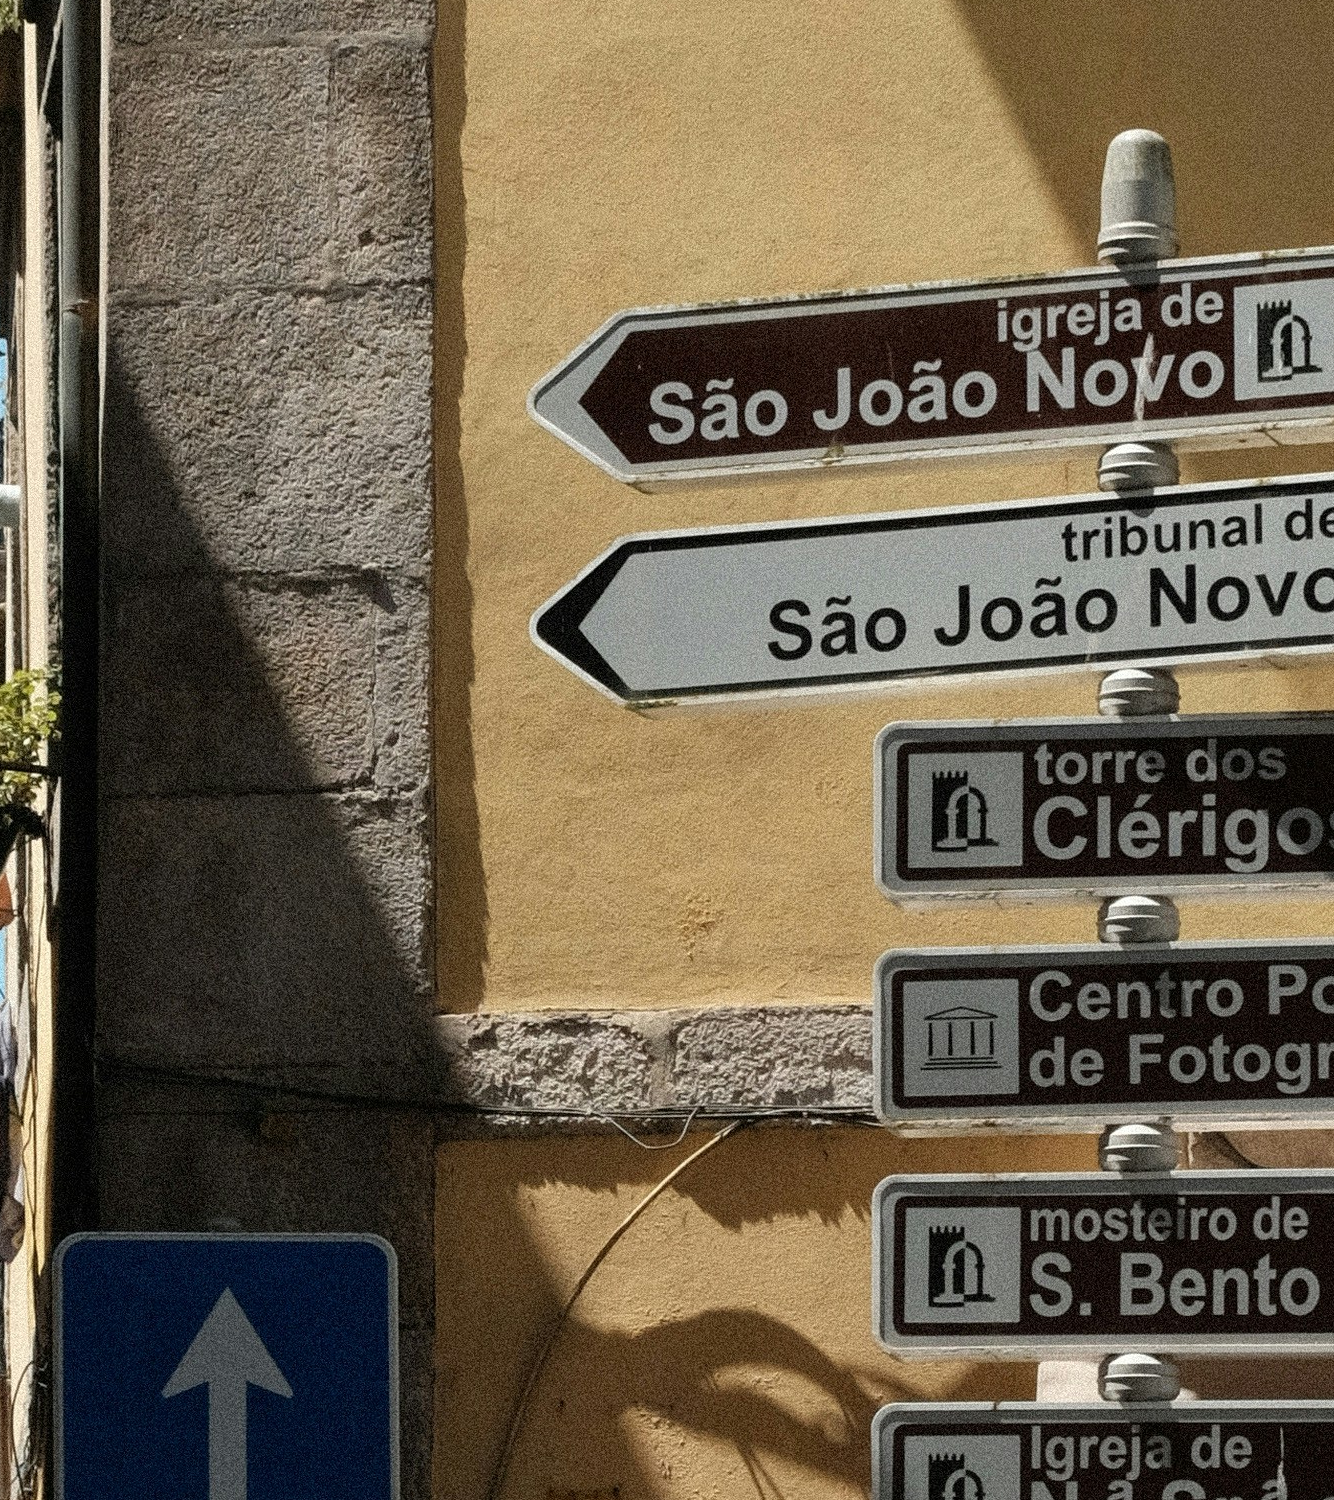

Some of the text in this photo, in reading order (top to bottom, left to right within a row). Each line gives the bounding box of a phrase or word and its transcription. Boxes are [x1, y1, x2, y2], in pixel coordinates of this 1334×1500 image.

[996, 282, 1224, 352] igreja de
[648, 342, 1225, 445] São João Novo
[1062, 504, 1262, 562] tribunal
[768, 596, 906, 660] São
[935, 577, 1117, 646] João
[1034, 738, 1286, 785] torre dos
[1029, 970, 1244, 1022] Centro
[1029, 1036, 1104, 1088] de
[1030, 1197, 1309, 1242] mosteiro de
[1029, 1251, 1092, 1318] S.
[1120, 1252, 1320, 1317] Bento
[1031, 1426, 1252, 1476] Igreja de
